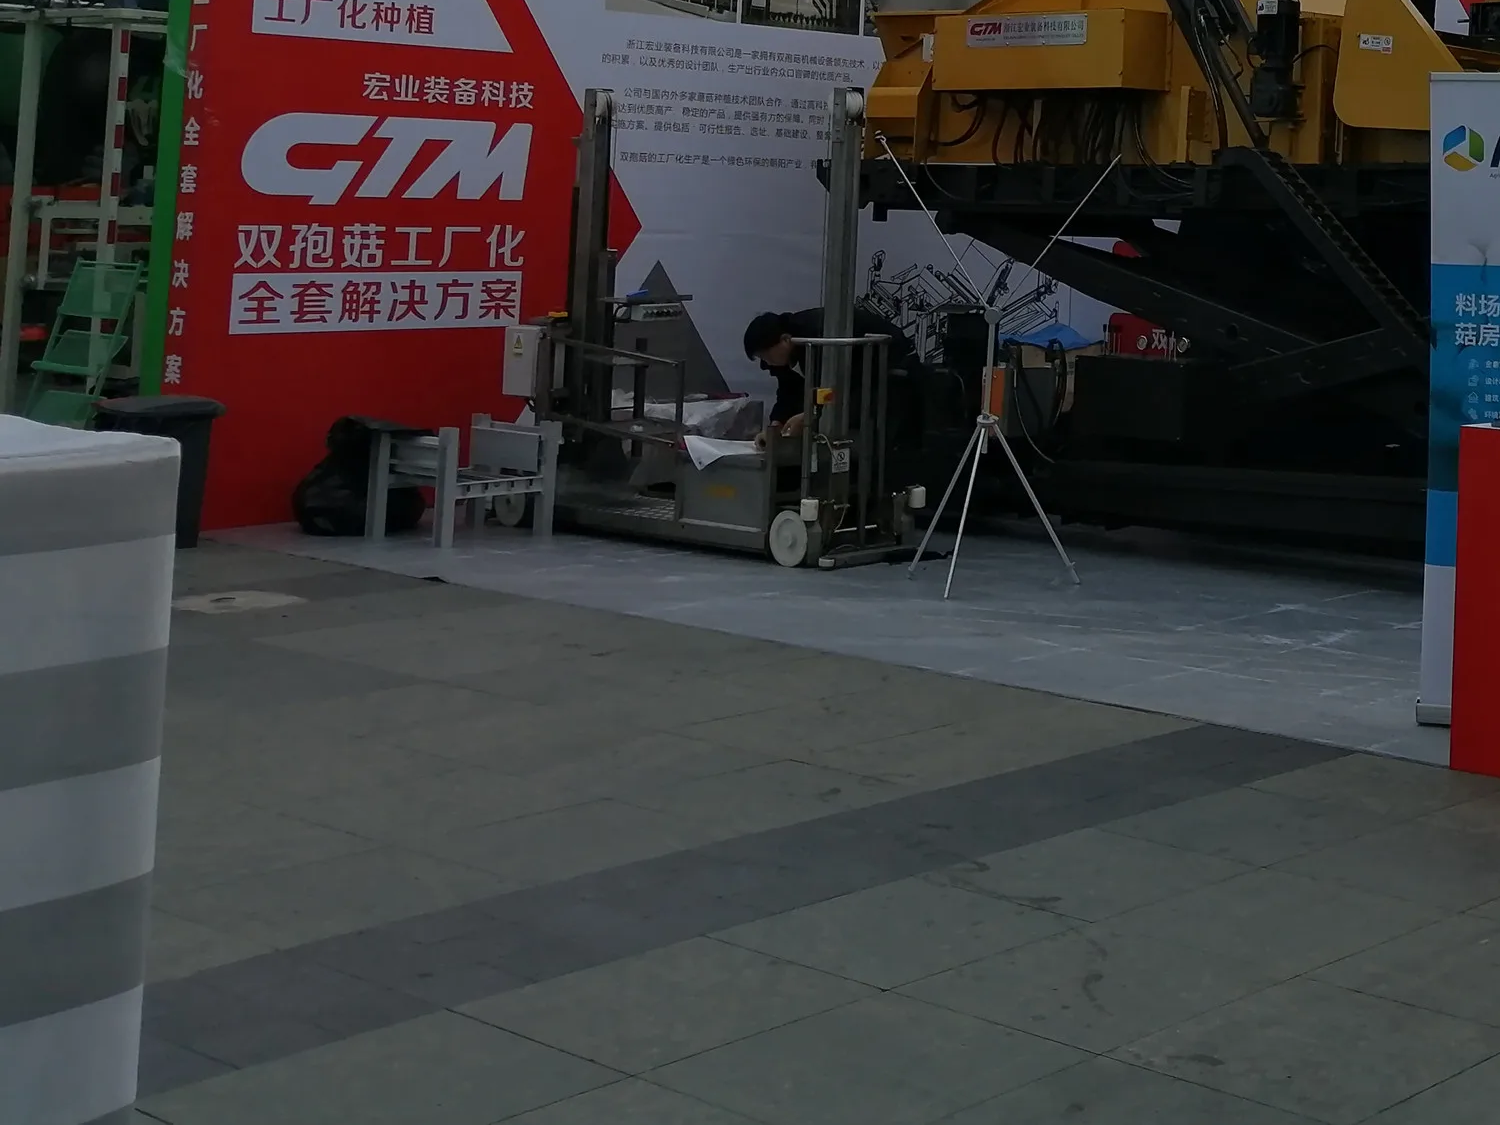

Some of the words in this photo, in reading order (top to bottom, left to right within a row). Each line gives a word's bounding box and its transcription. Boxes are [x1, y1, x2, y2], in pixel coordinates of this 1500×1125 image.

[970, 22, 1002, 36] GTM
[362, 72, 535, 109] 宏业装备科技
[240, 112, 534, 205] GTM
[234, 223, 526, 269] 双孢菇工厂化
[238, 278, 518, 325] 全套解决方案
